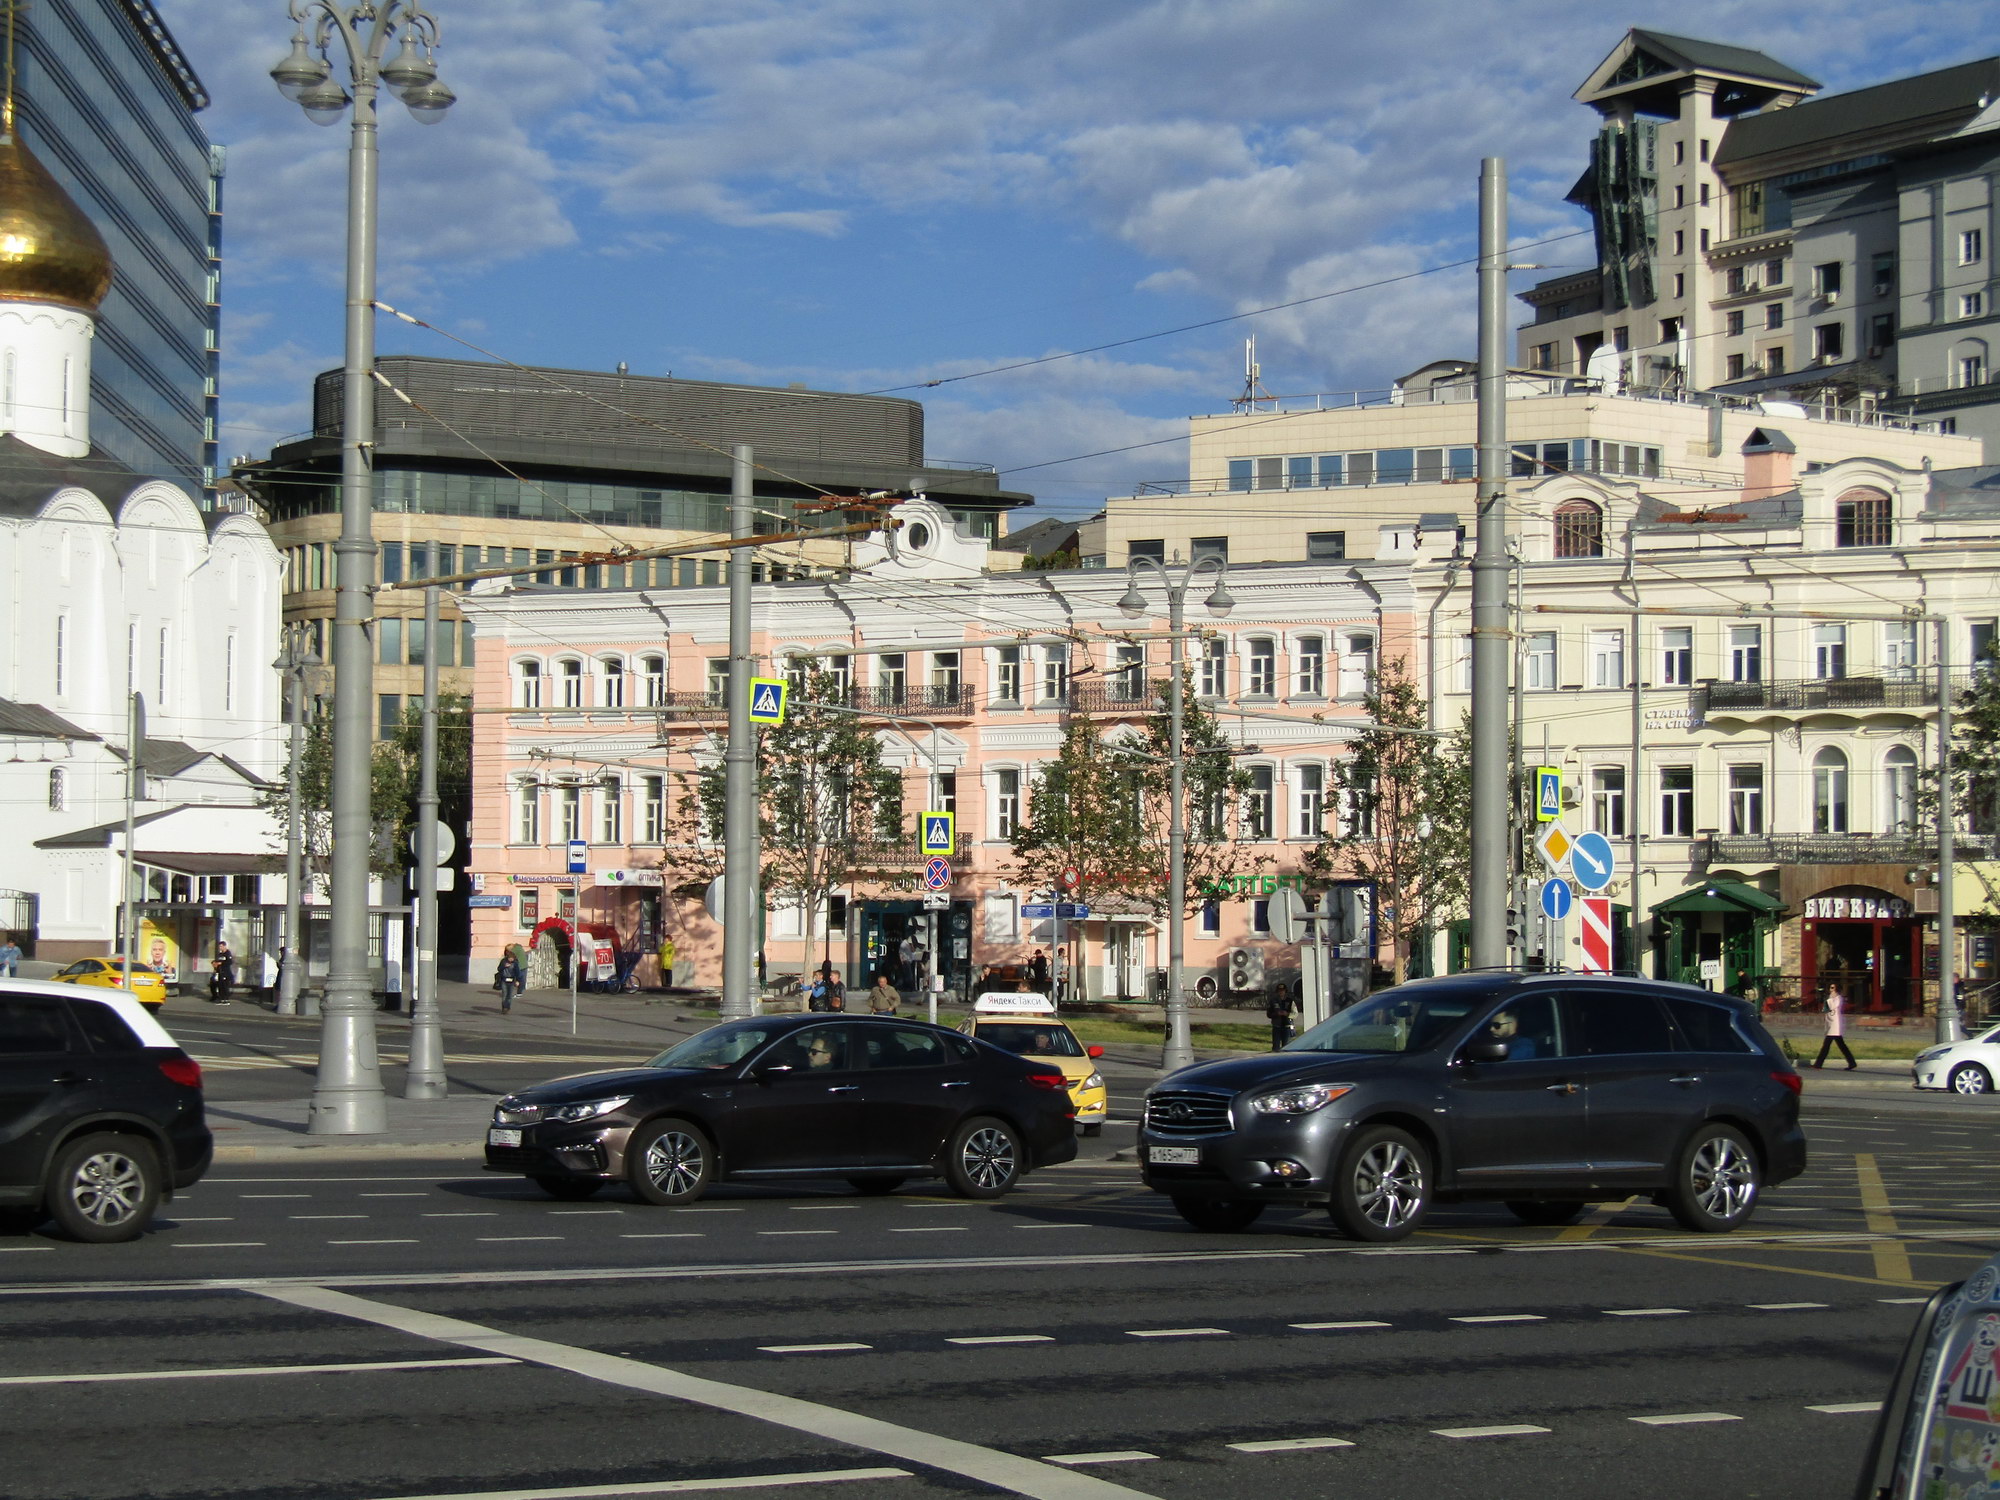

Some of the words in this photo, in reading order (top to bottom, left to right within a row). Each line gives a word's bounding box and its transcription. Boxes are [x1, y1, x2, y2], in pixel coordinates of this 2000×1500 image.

[1645, 708, 1695, 719] СТАВКИ
[1646, 720, 1664, 730] НА
[1666, 719, 1706, 729] СПОРТ
[1804, 898, 1844, 918] БИР
[1704, 964, 1718, 975] СТОП
[987, 995, 1017, 1006] Яндекс
[1018, 996, 1042, 1006] Такси
